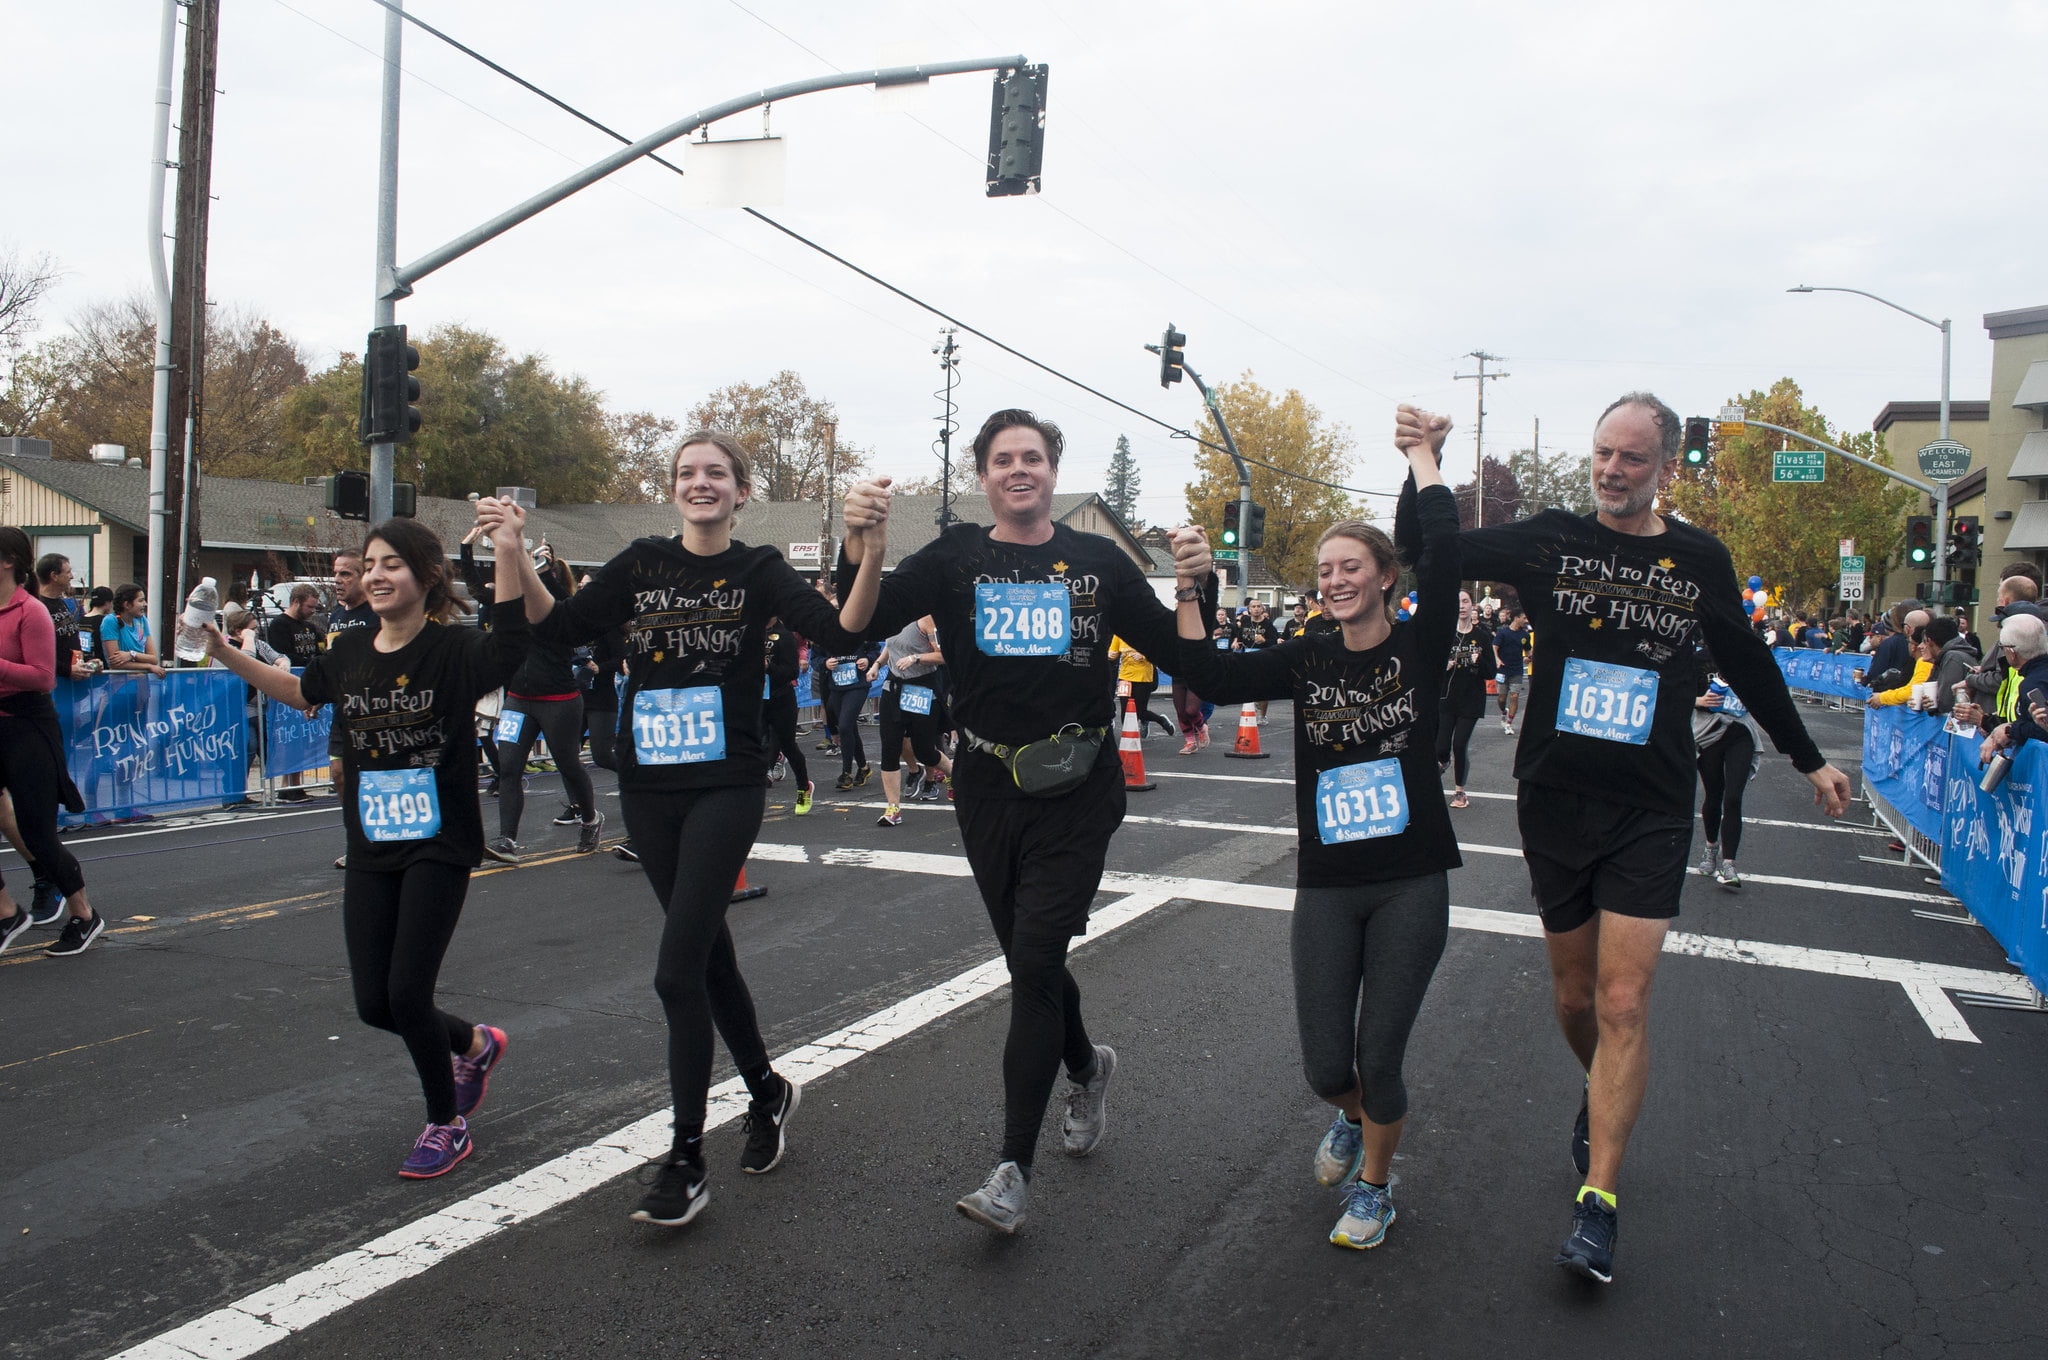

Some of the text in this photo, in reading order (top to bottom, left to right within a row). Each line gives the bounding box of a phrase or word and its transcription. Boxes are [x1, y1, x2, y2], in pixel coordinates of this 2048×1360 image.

[1776, 454, 1804, 465] Elvas
[1918, 448, 1971, 457] WELCOME
[1932, 460, 1956, 468] EAST
[1924, 468, 1965, 476] SACRAMENTO
[1557, 554, 1617, 582] RUN
[1618, 566, 1643, 581] TO
[1636, 588, 1655, 600] DAY
[1843, 588, 1861, 598] 30
[983, 607, 1063, 640] 22488
[1004, 643, 1053, 655] Save Mart
[833, 670, 857, 682] 27649
[372, 696, 389, 710] TO
[900, 693, 929, 710] 27501
[1564, 683, 1649, 728] 16316
[92, 711, 148, 759] RUN
[145, 721, 170, 738] TO
[639, 710, 716, 748] 16315
[1581, 723, 1632, 741] Save Mart
[660, 751, 706, 762] Save Mart
[362, 792, 433, 826] 21499
[1321, 784, 1400, 828] 16313
[399, 828, 423, 839] Mart
[1344, 825, 1393, 840] Save Mart
